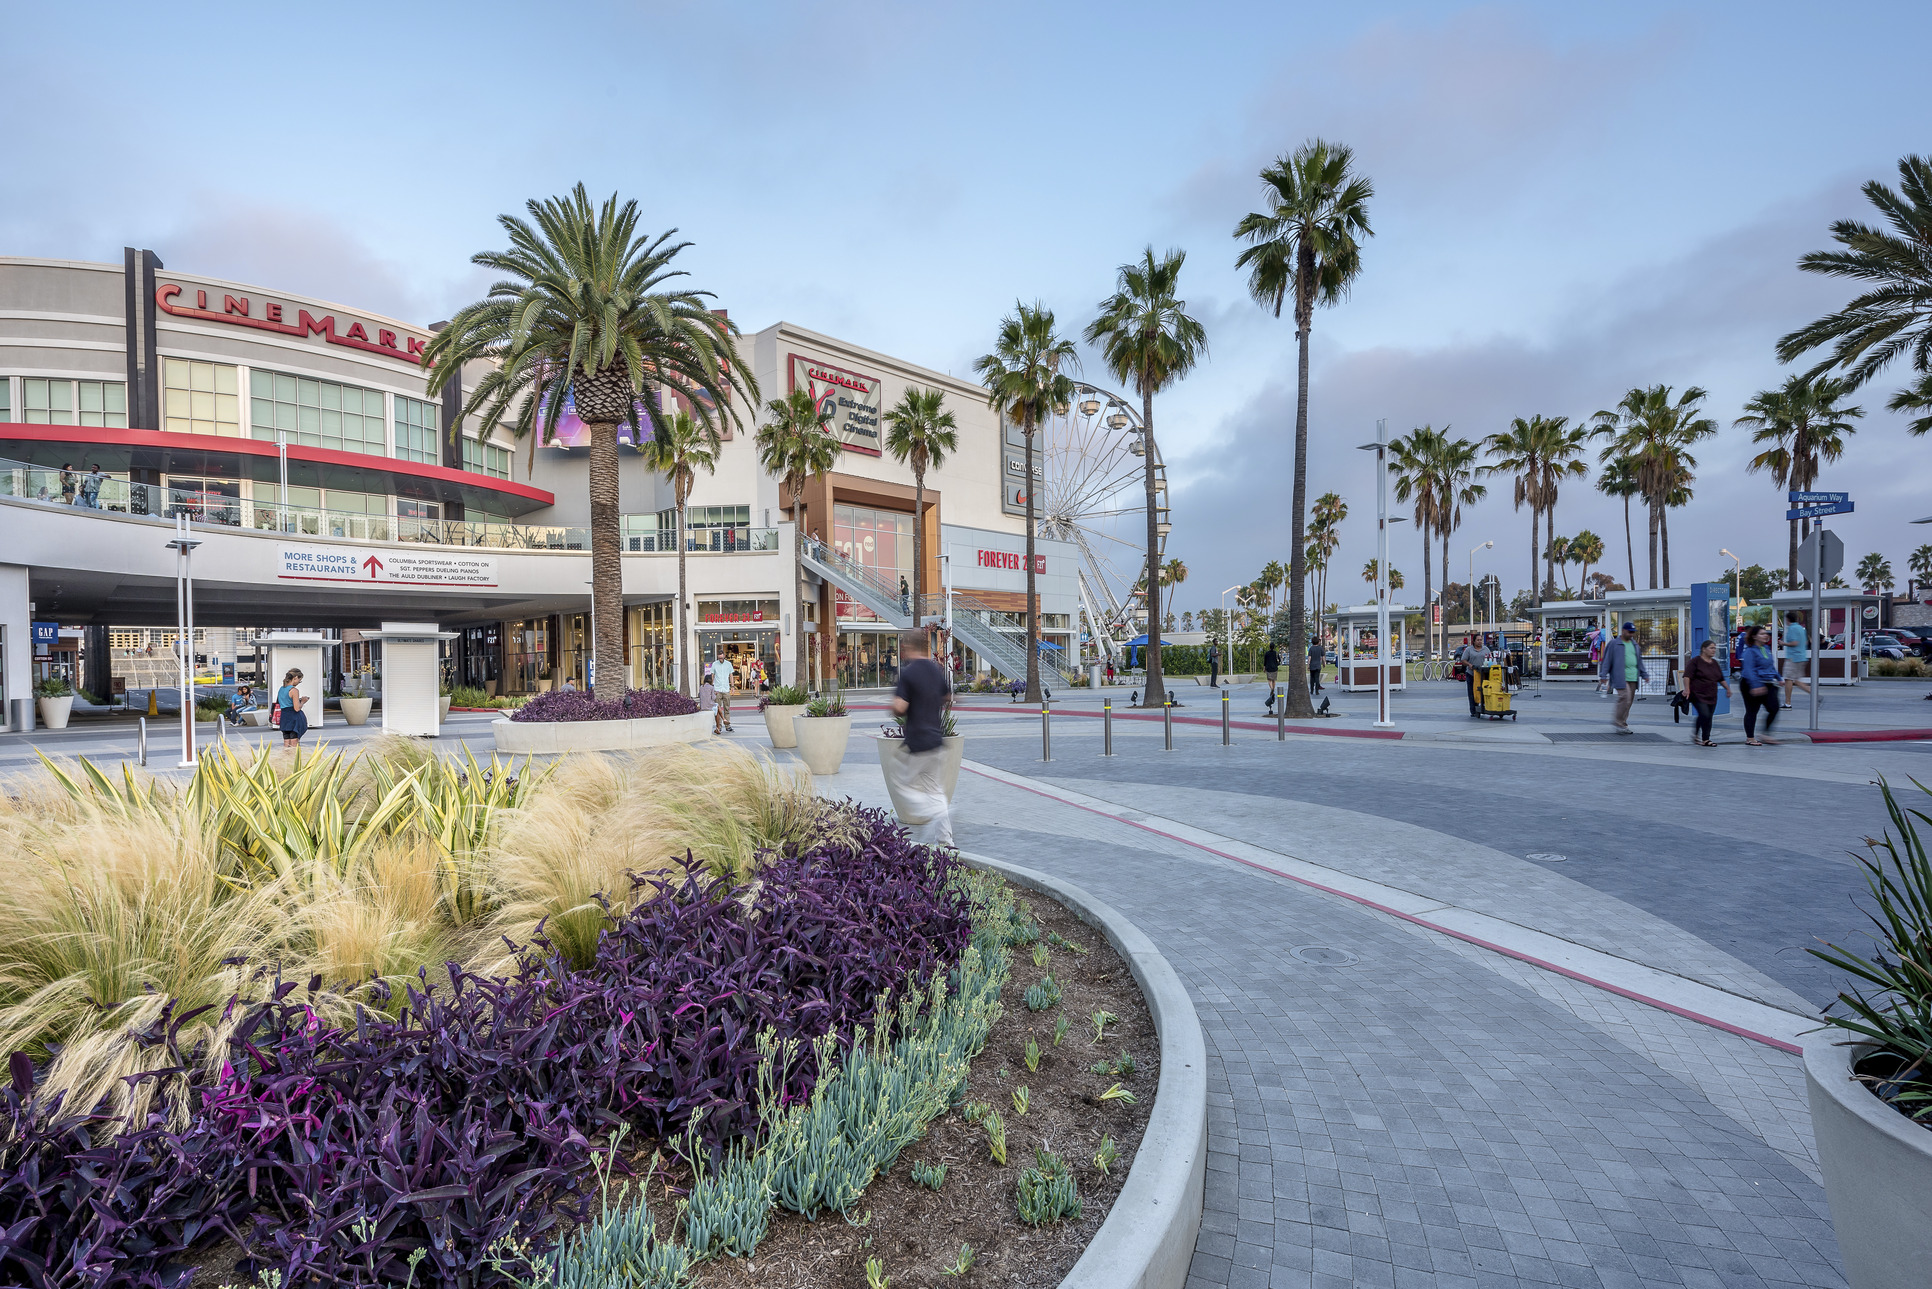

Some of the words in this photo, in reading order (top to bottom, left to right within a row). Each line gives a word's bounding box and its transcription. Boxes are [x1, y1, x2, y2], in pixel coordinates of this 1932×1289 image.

[155, 283, 437, 368] CINEMARK
[808, 368, 870, 393] CINEMARK
[839, 396, 877, 414] Extreme
[848, 411, 878, 426] Digital
[843, 422, 878, 438] Cinema
[1798, 493, 1828, 503] Aquarium
[1829, 493, 1843, 503] Way
[1800, 509, 1812, 517] Bay
[1814, 505, 1837, 515] Street
[284, 551, 313, 562] MORE
[316, 554, 347, 564] SHOPS
[350, 556, 357, 565] &
[978, 549, 1020, 570] FOREVER
[1023, 554, 1028, 571] 2
[286, 562, 356, 575] RESTAURANTS
[1709, 586, 1728, 594] DIRECTORY
[705, 613, 739, 623] FOREVER
[741, 612, 750, 623] 21
[38, 627, 54, 637] GAP
